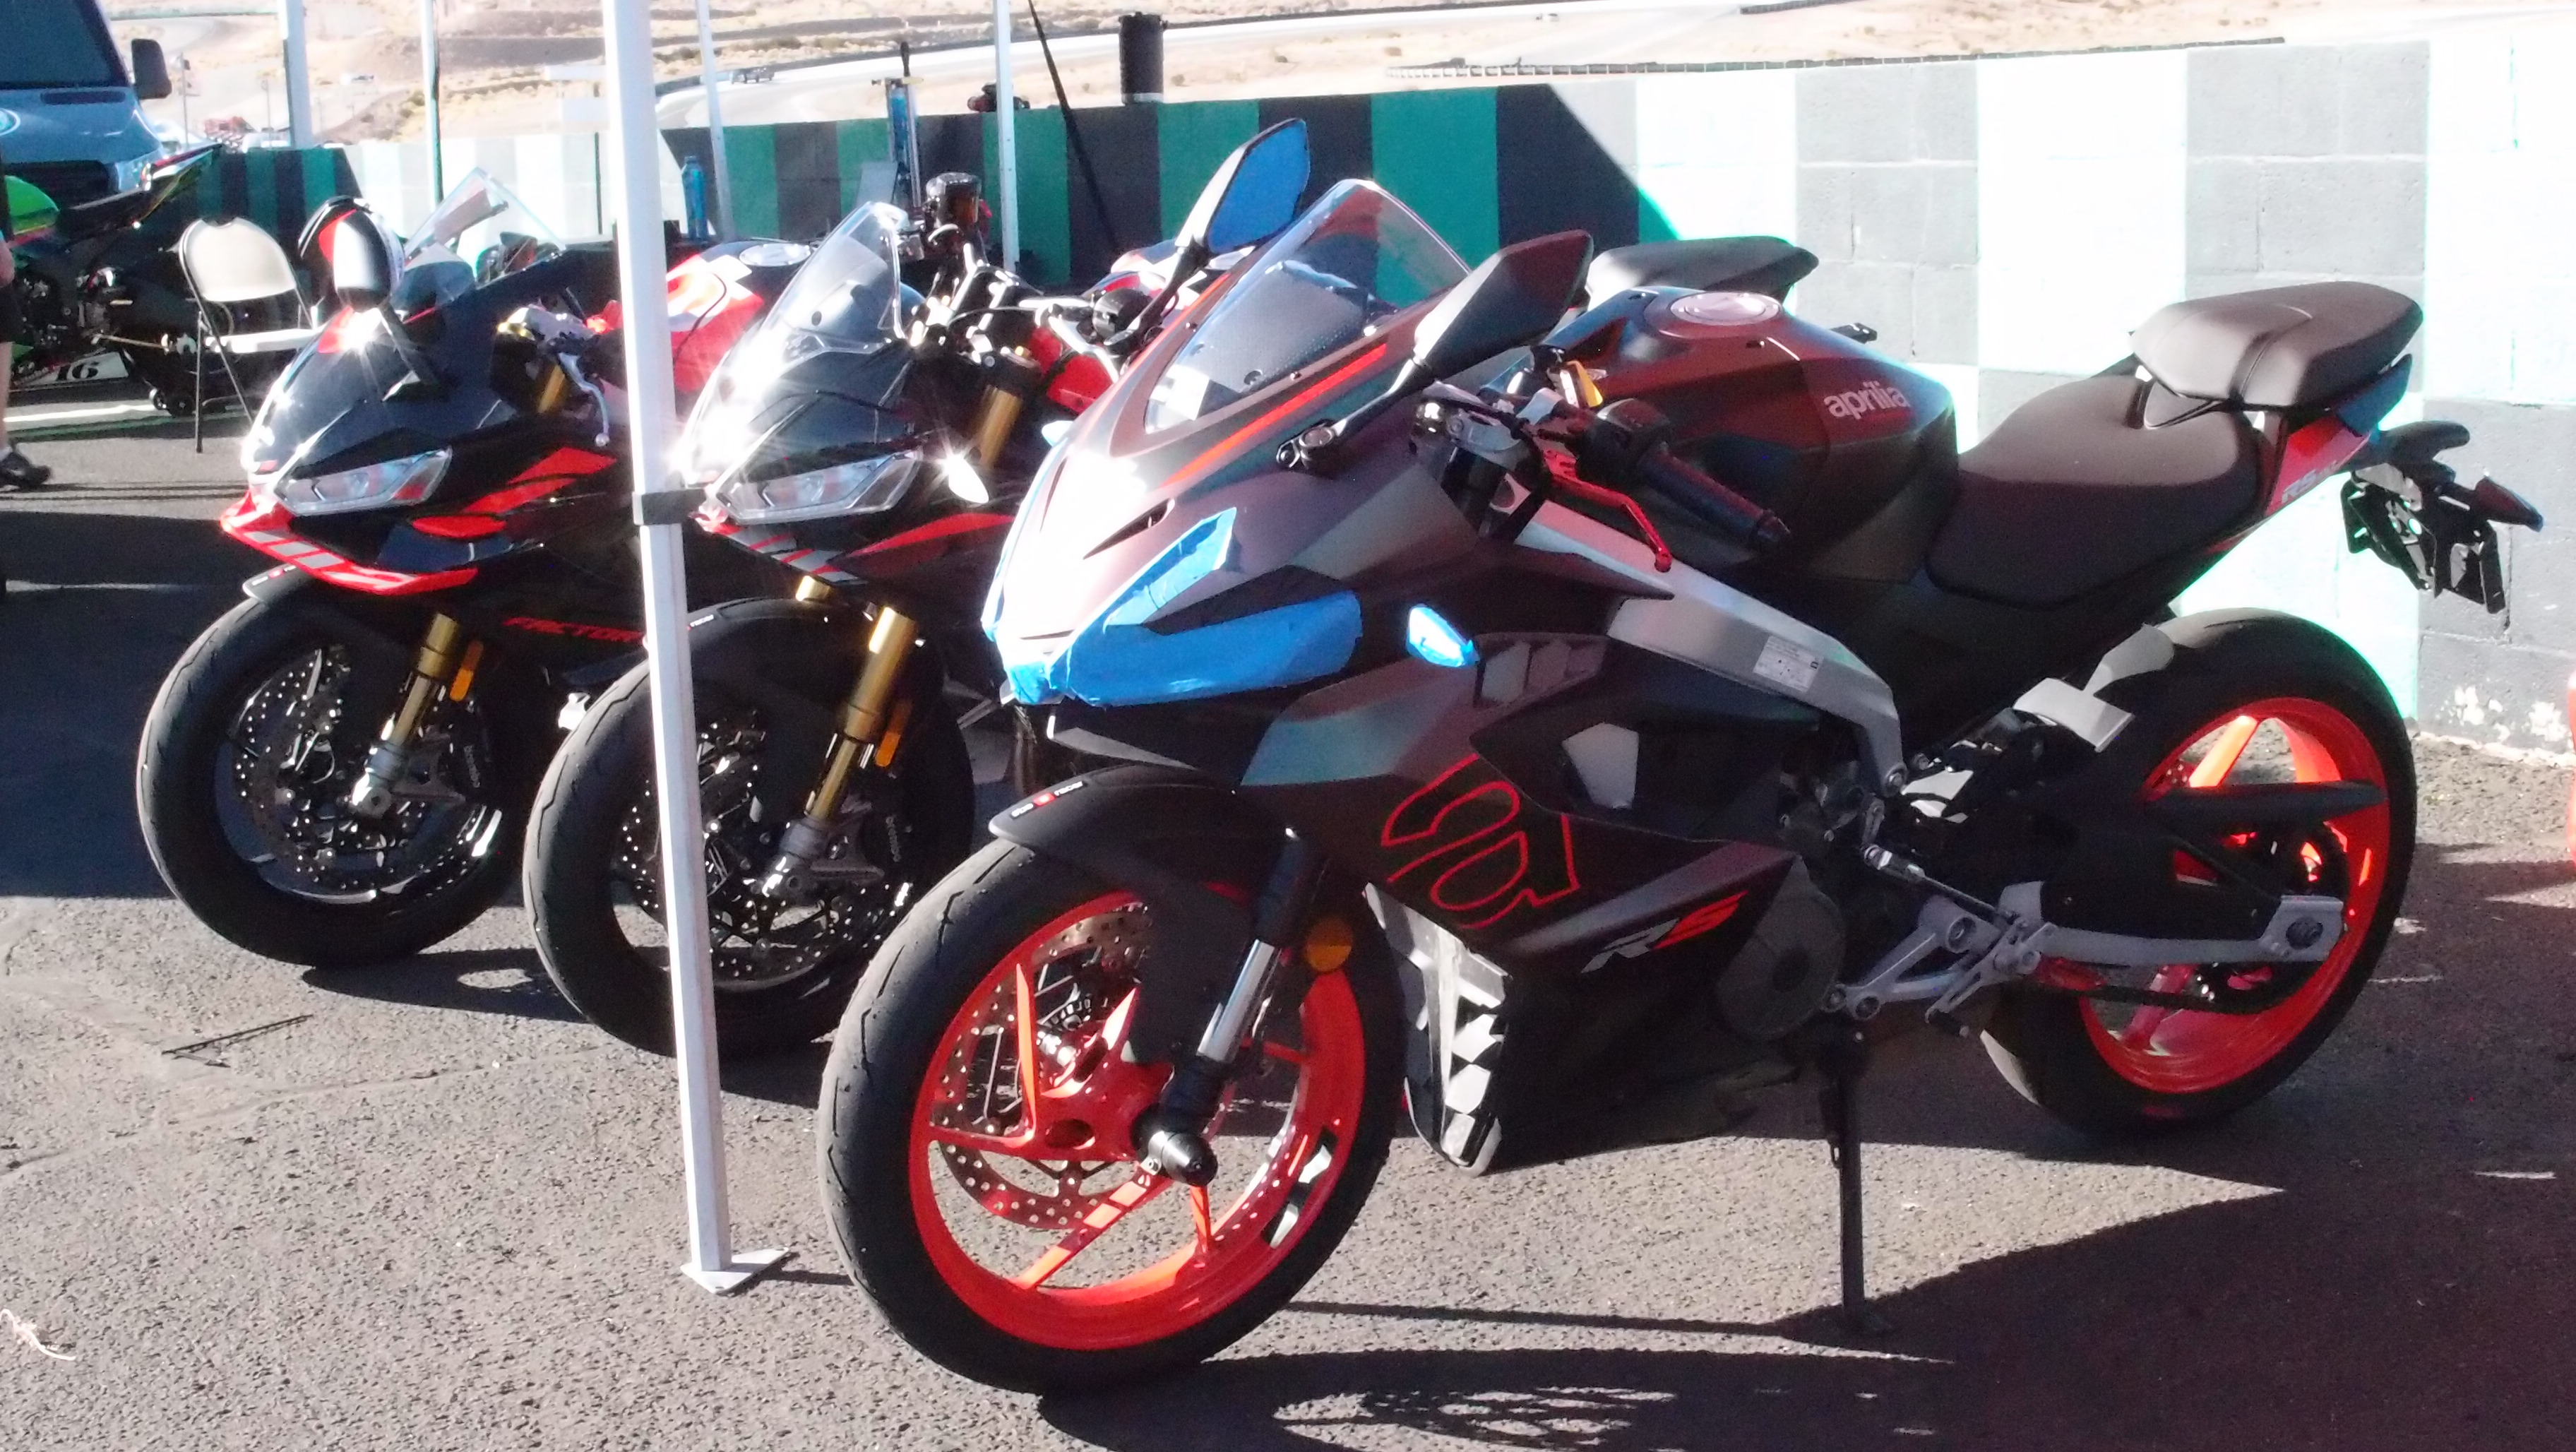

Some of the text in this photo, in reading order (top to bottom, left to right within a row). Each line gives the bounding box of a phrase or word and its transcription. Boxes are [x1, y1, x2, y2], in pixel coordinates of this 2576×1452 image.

[56, 361, 99, 381] 16
[1823, 381, 1911, 419] aprilia
[503, 617, 642, 643] FACTOR
[1581, 890, 1749, 974] RS
